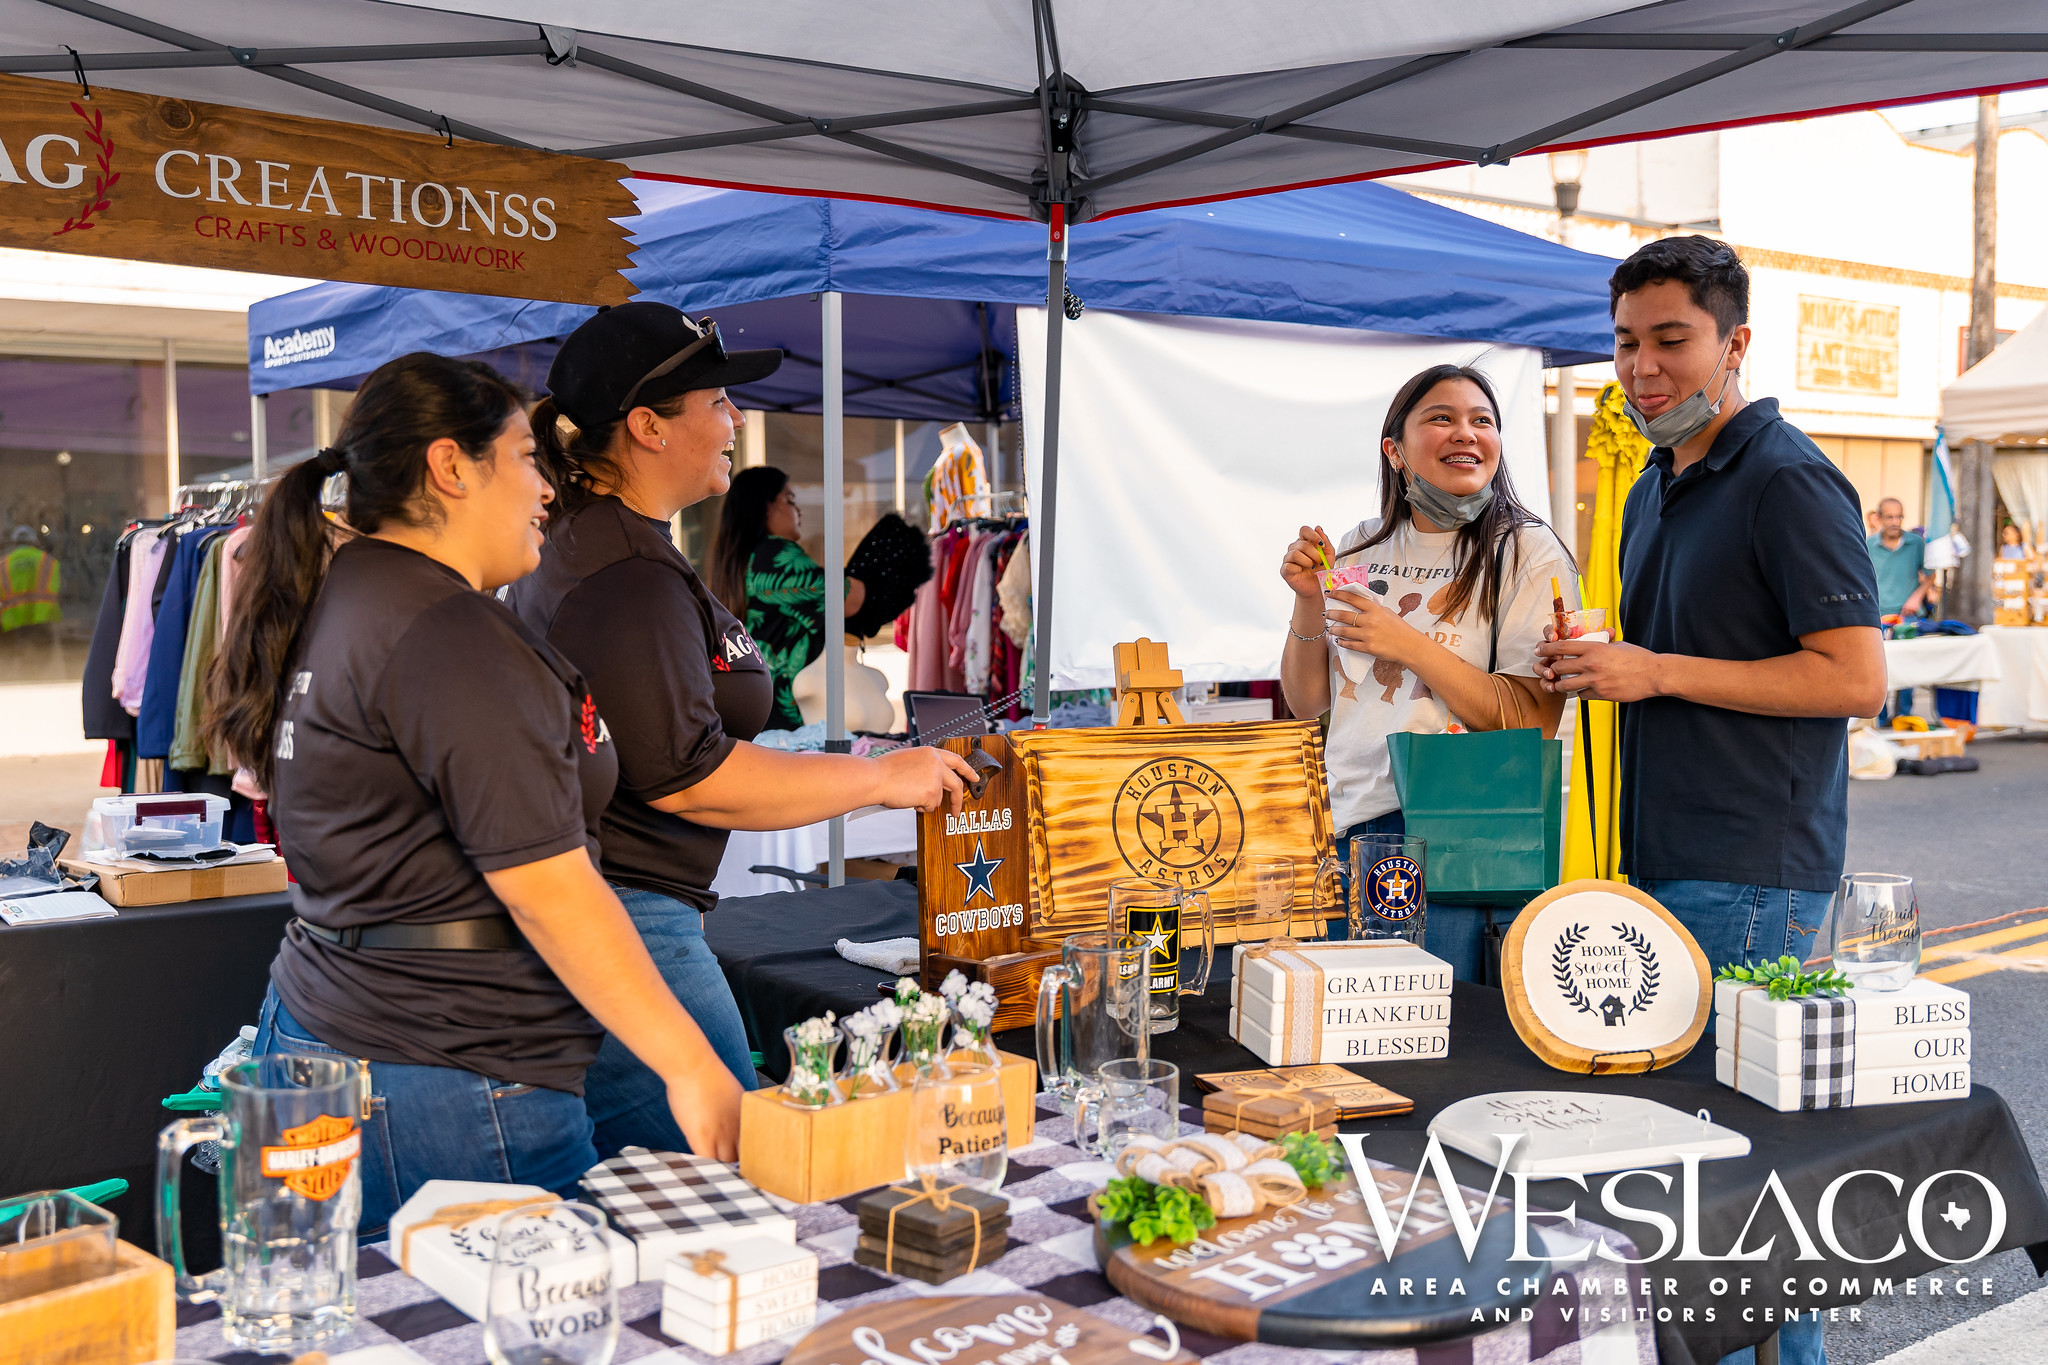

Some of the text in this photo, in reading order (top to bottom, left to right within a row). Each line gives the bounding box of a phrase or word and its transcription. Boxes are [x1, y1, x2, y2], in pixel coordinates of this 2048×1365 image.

[155, 149, 557, 241] CREATIONSS
[194, 215, 526, 271] CRAFTS & WOODWORK
[264, 325, 336, 360] Academy
[1367, 562, 1464, 580] BEAUTIFU
[724, 633, 753, 664] AG
[1125, 762, 1224, 802] HOUSTON
[945, 807, 1012, 836] DALLAS
[1139, 852, 1228, 886] ASTROS
[1373, 859, 1419, 878] HOUSTON
[935, 903, 1024, 937] COWBOYS
[1374, 902, 1417, 919] ASTROS
[1581, 945, 1628, 957] HOME
[1574, 957, 1637, 977] sweet
[1327, 973, 1451, 995] GRATEFUL
[1586, 977, 1632, 989] HOME
[1323, 1004, 1449, 1025] THANKFUL
[1893, 1001, 1966, 1026] BLESS
[1346, 1035, 1447, 1057] BLESSED
[1914, 1037, 1967, 1059] OUR
[1891, 1070, 1966, 1095] HOME
